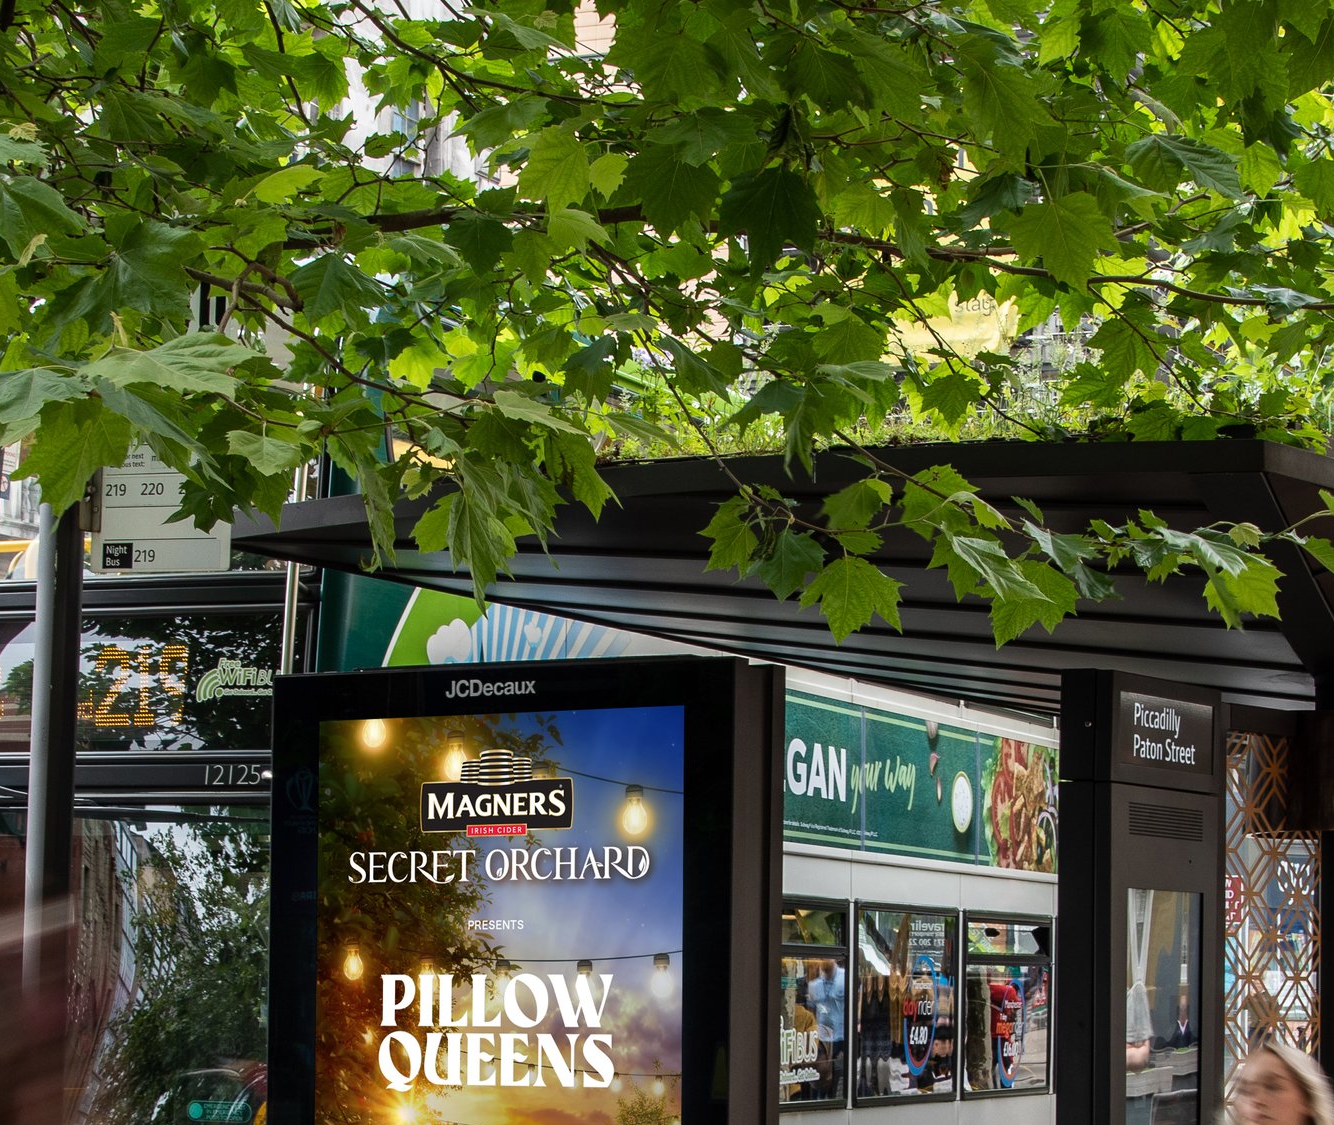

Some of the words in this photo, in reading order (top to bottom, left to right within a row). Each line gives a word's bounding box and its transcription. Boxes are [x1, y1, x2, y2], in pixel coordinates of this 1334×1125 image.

[105, 483, 127, 496] 219
[140, 483, 164, 496] 220
[106, 546, 128, 556] Night
[134, 549, 156, 563] 219
[105, 557, 120, 566] Bus
[95, 645, 189, 727] 219
[445, 679, 536, 698] JCDecaux
[1134, 702, 1181, 739] Piccadilly
[1133, 734, 1163, 760] Paton
[1165, 738, 1196, 765] Street
[204, 765, 261, 785] 12125
[784, 738, 847, 802] GAN
[427, 787, 567, 820] MAGNERS
[471, 826, 494, 834] IRISH
[497, 825, 523, 834] CIDER
[348, 850, 475, 884] SECRET
[485, 845, 650, 882] ORCHARD
[467, 919, 524, 930] PRESENTS
[380, 973, 614, 1028] PILLOW
[903, 994, 935, 1023] dayrider
[909, 1025, 928, 1045] £4.80
[378, 1030, 615, 1092] QUEENS
